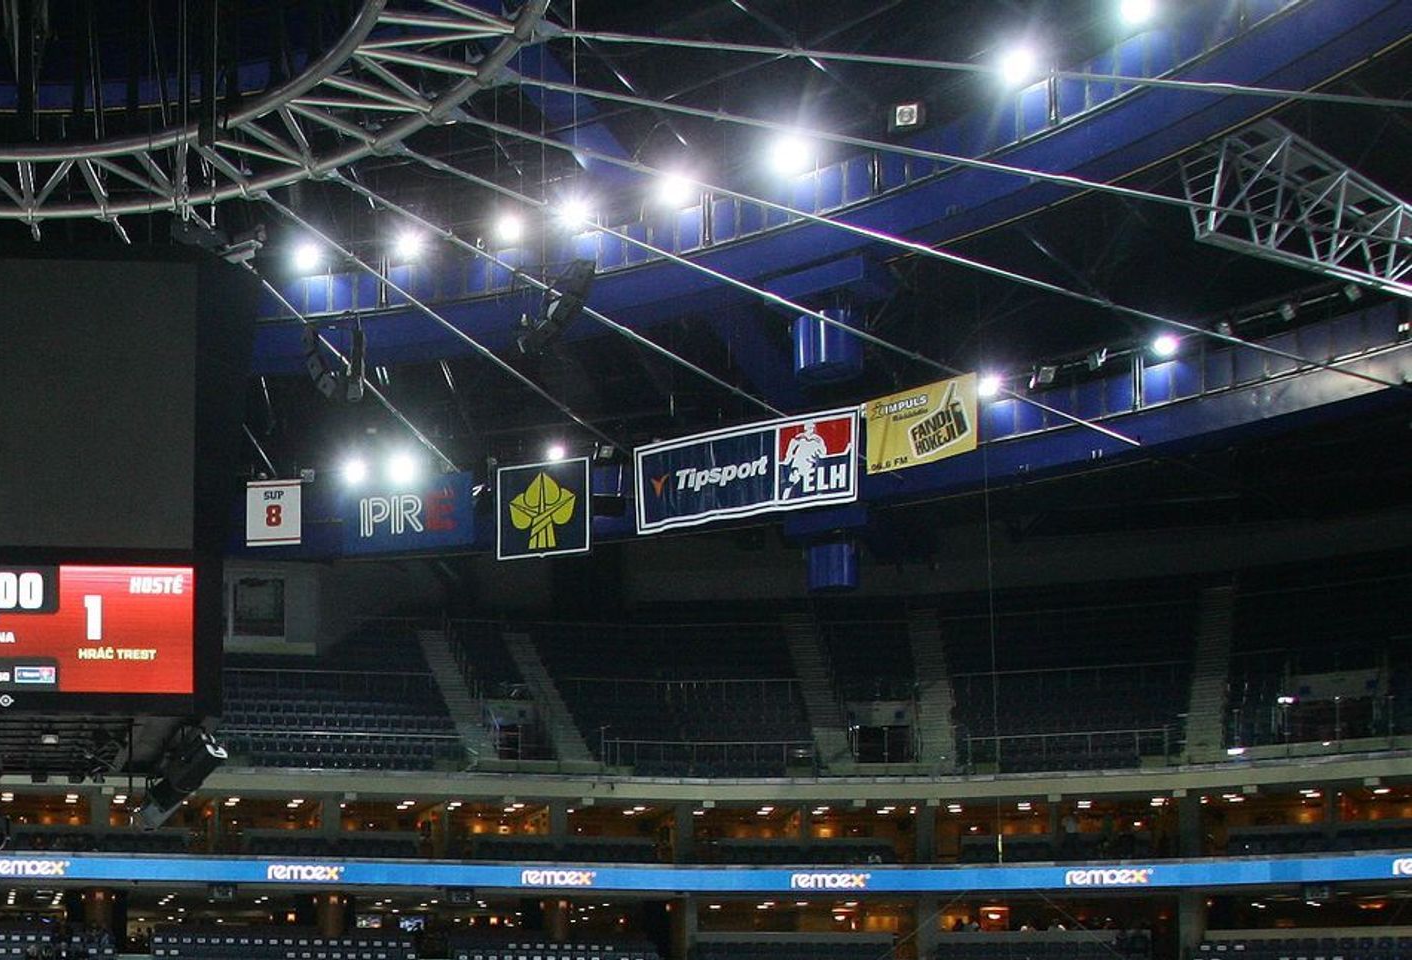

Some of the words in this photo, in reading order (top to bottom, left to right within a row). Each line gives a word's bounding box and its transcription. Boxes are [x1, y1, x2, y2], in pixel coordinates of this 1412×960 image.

[884, 394, 928, 415] IMPULS
[676, 455, 768, 493] Tipsport
[802, 463, 847, 493] ELH
[265, 504, 282, 527] 8
[360, 493, 457, 537] PRE
[84, 595, 102, 640] 1
[78, 647, 114, 660] HRÁČ
[116, 649, 157, 660] TREST
